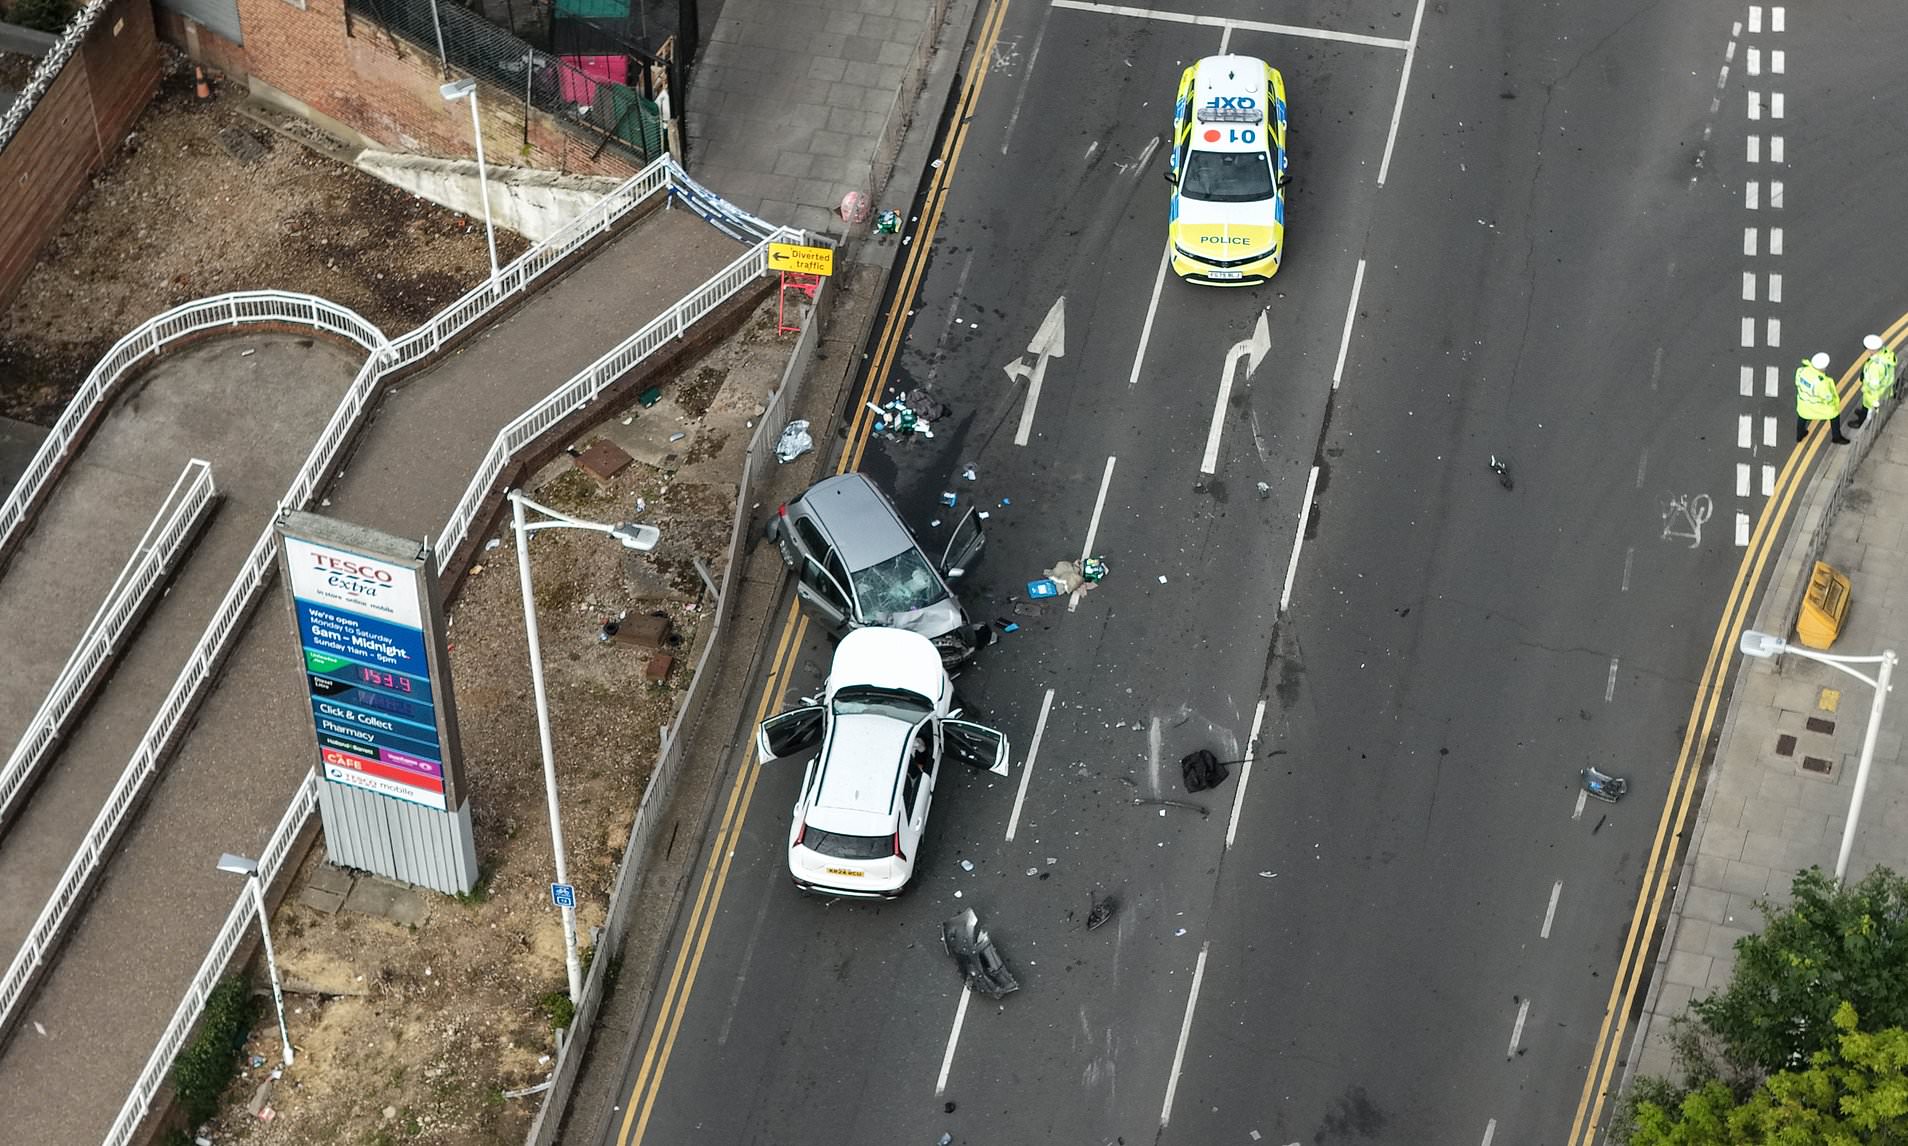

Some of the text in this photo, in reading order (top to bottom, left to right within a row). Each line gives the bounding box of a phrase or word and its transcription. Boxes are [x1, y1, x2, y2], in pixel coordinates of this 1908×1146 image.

[1206, 96, 1256, 109] QXF
[1229, 129, 1256, 144] 01
[1200, 236, 1251, 246] POLICE
[792, 250, 830, 262] Diverted
[797, 261, 825, 271] traffic
[310, 552, 392, 583] TESCO
[328, 576, 377, 597] extra
[309, 608, 359, 628] We're open
[310, 617, 393, 645] Monday to Saturday
[311, 625, 341, 641] 6am
[313, 637, 345, 652] Sunday
[347, 645, 368, 657] 11am
[376, 653, 397, 665] 5pm
[362, 667, 412, 693] 153.9
[320, 703, 393, 731] Click & Collect
[322, 720, 375, 742] Pharmacy
[380, 783, 414, 797] mobile
